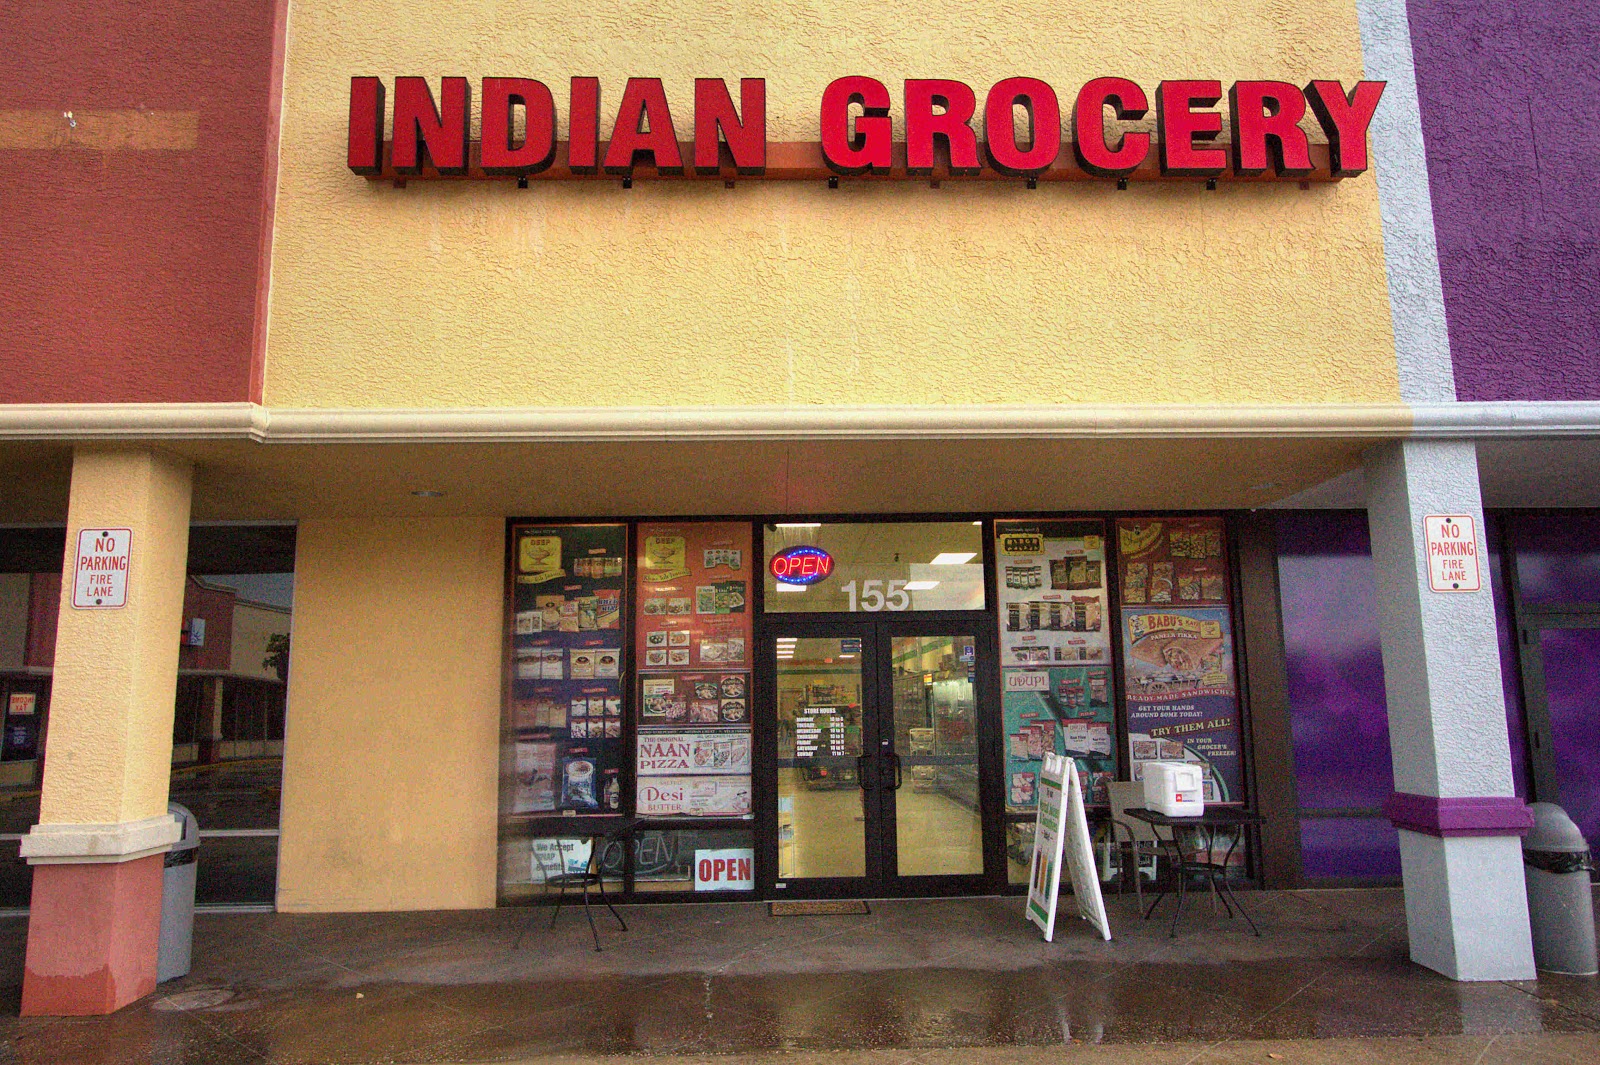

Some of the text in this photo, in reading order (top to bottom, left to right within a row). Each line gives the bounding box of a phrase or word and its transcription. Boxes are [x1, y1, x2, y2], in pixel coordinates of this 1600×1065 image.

[347, 75, 1387, 176] INDIAN GROCERY
[1441, 524, 1460, 539] NO
[95, 537, 115, 553] NO
[1431, 541, 1474, 556] PARKING
[80, 555, 126, 571] PARKING
[773, 557, 830, 575] OPEN
[1443, 559, 1464, 569] FIRE
[90, 574, 112, 585] FIRE
[1442, 571, 1467, 581] LANE
[86, 586, 113, 597] LANE
[841, 579, 910, 612] 155
[1009, 675, 1046, 687] UDUPI
[1182, 688, 1236, 698] SANDWICHES
[1151, 718, 1231, 737] TRY THEM ALL!
[640, 743, 691, 758] NAAN
[640, 759, 690, 769] PIZZA
[639, 786, 683, 805] Desi
[647, 803, 682, 811] BUTTER
[536, 862, 563, 871] Bnefit
[698, 858, 751, 882] OPEN
